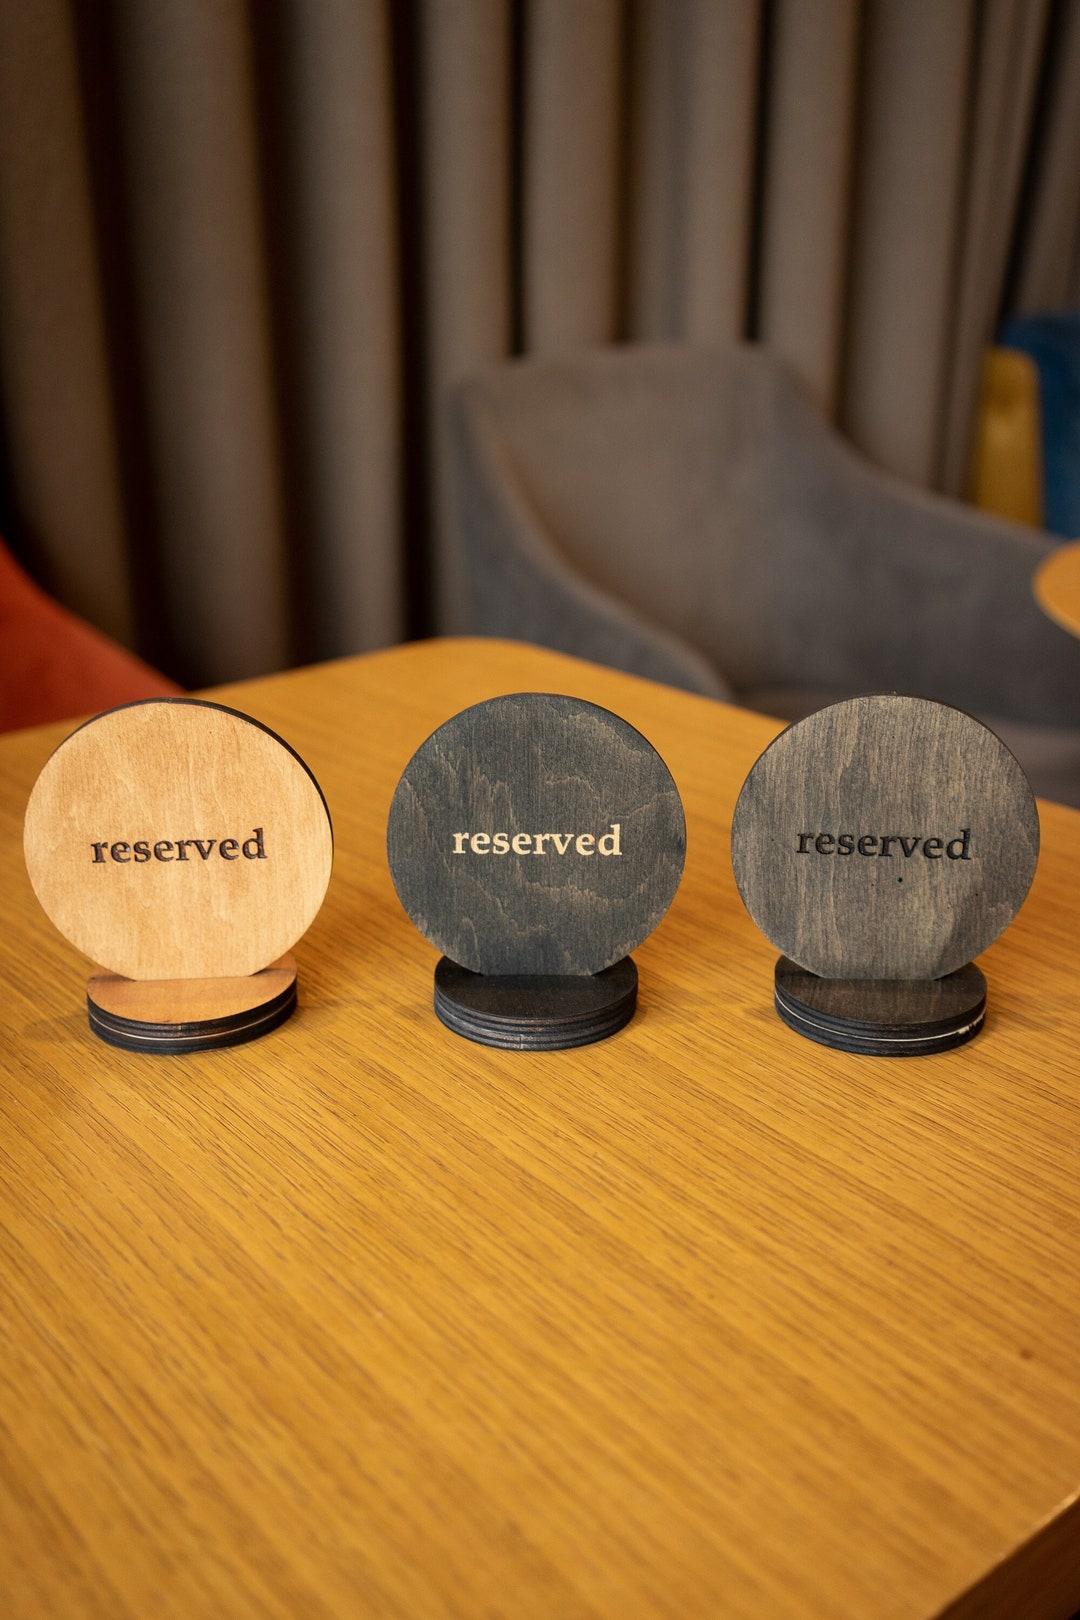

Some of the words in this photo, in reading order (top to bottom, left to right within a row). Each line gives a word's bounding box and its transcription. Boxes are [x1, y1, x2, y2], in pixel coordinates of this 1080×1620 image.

[91, 827, 268, 864] reserved
[452, 823, 623, 856] reserved
[796, 828, 971, 861] reserved
